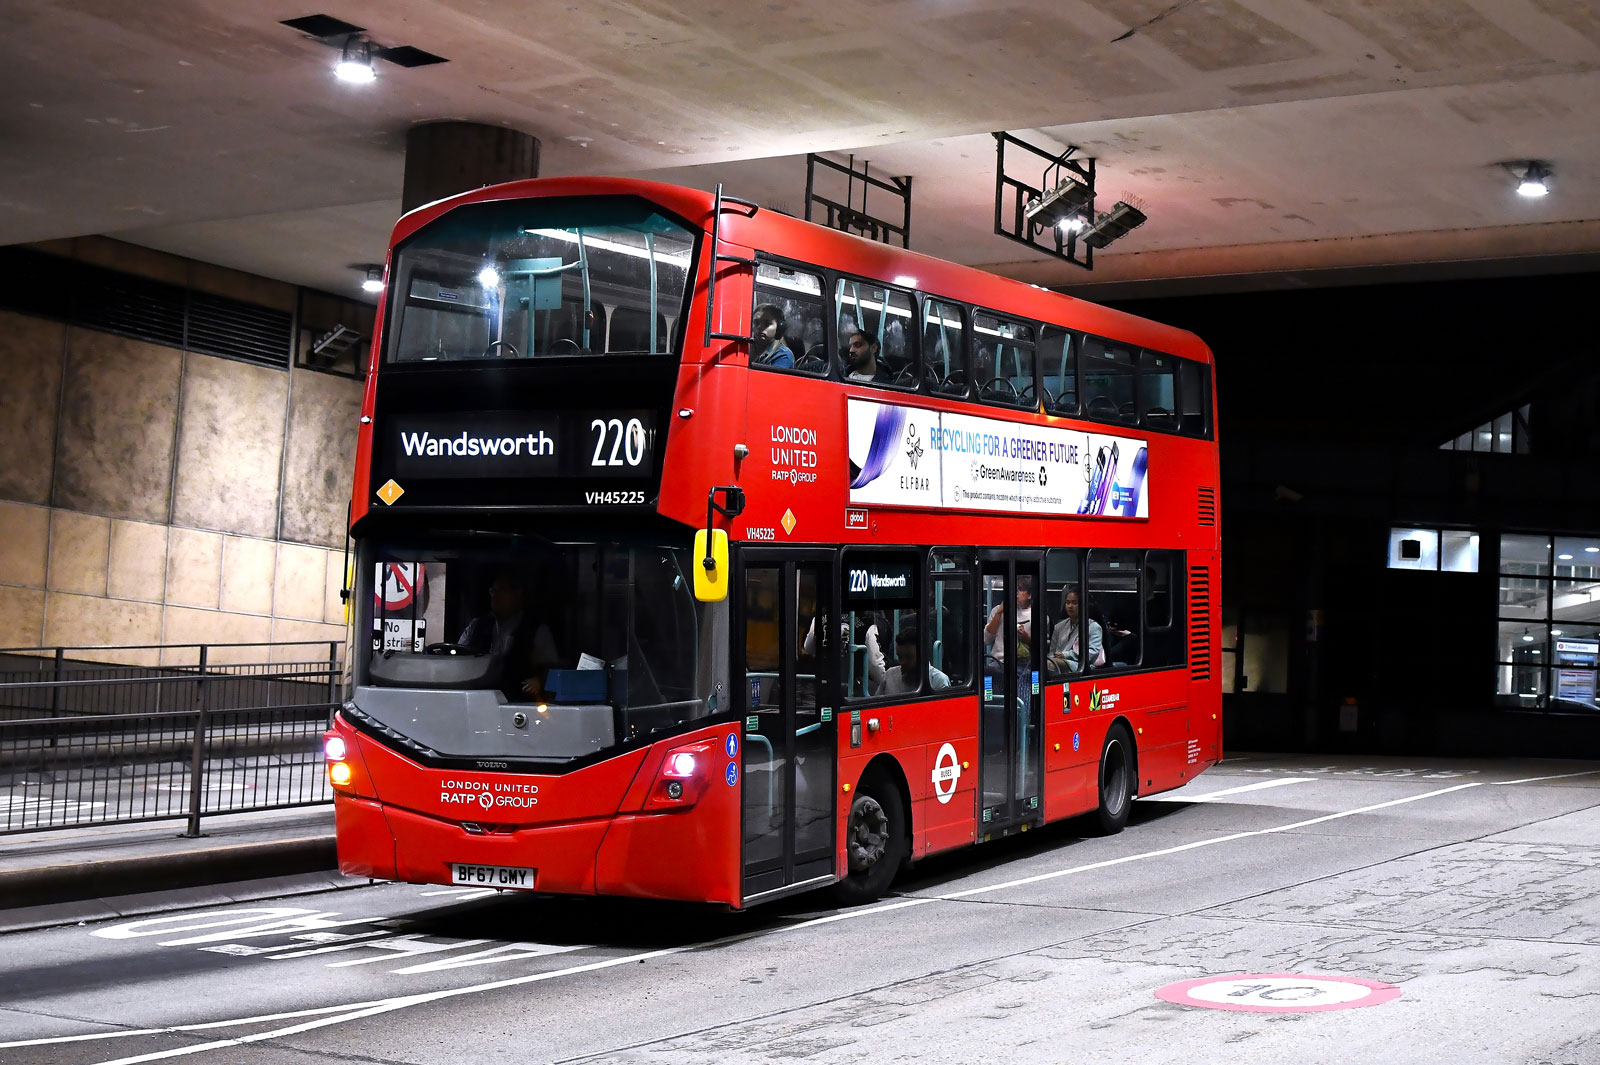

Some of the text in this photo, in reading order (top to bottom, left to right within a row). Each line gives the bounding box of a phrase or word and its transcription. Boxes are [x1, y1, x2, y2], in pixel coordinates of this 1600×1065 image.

[590, 418, 644, 466] 220
[771, 425, 817, 446] LONDON
[401, 431, 554, 456] Wandsworth
[930, 427, 1079, 465] RECYCLING FOR A GREENER FUTURE
[771, 448, 817, 467] UNITED
[771, 470, 817, 483] RATP GROUP
[979, 464, 1036, 483] GreenAwareness
[900, 476, 930, 491] ELFBAR
[585, 491, 645, 504] VH45225
[849, 512, 864, 525] global
[746, 527, 775, 540] VH45225
[850, 569, 906, 592] 220 Wandsworth
[385, 622, 400, 633] No
[476, 761, 508, 769] VOLVO
[940, 769, 952, 778] BUSES
[441, 780, 539, 794] LONDON UNITED
[440, 792, 538, 808] RATP GROUP
[458, 866, 527, 885] BF67 GMY
